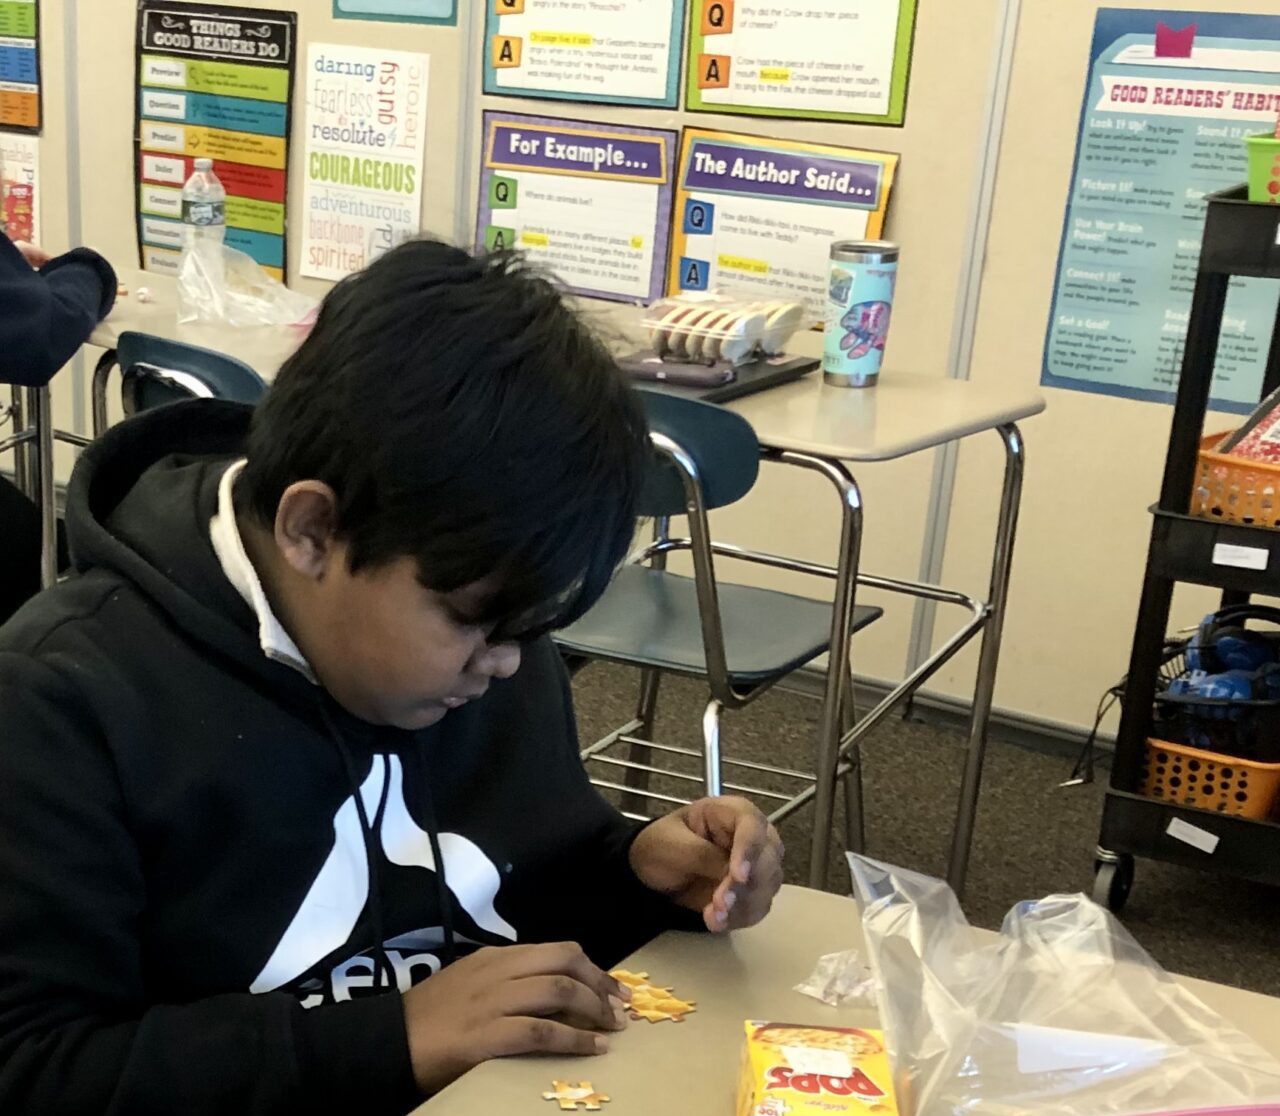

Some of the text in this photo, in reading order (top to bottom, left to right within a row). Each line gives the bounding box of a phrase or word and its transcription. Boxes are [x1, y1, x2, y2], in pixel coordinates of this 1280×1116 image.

[190, 20, 241, 37] THINGS
[708, 4, 724, 27] Q
[153, 32, 280, 57] GOOD READERS DO
[499, 40, 513, 62] A
[315, 55, 376, 82] daring
[705, 59, 720, 82] A
[377, 61, 400, 125] gutsy
[1111, 84, 1148, 103] GOOD
[397, 65, 420, 149] heroic
[312, 122, 386, 148] resolute
[510, 132, 649, 171] For Example...
[309, 151, 416, 194] COURAGEOUS
[695, 152, 872, 197] The Author Said...
[495, 182, 508, 202] Q
[310, 189, 412, 224] adventurous
[690, 205, 704, 227] Q
[309, 246, 365, 272] spirited
[686, 263, 699, 285] A
[766, 1066, 886, 1097] POPS
